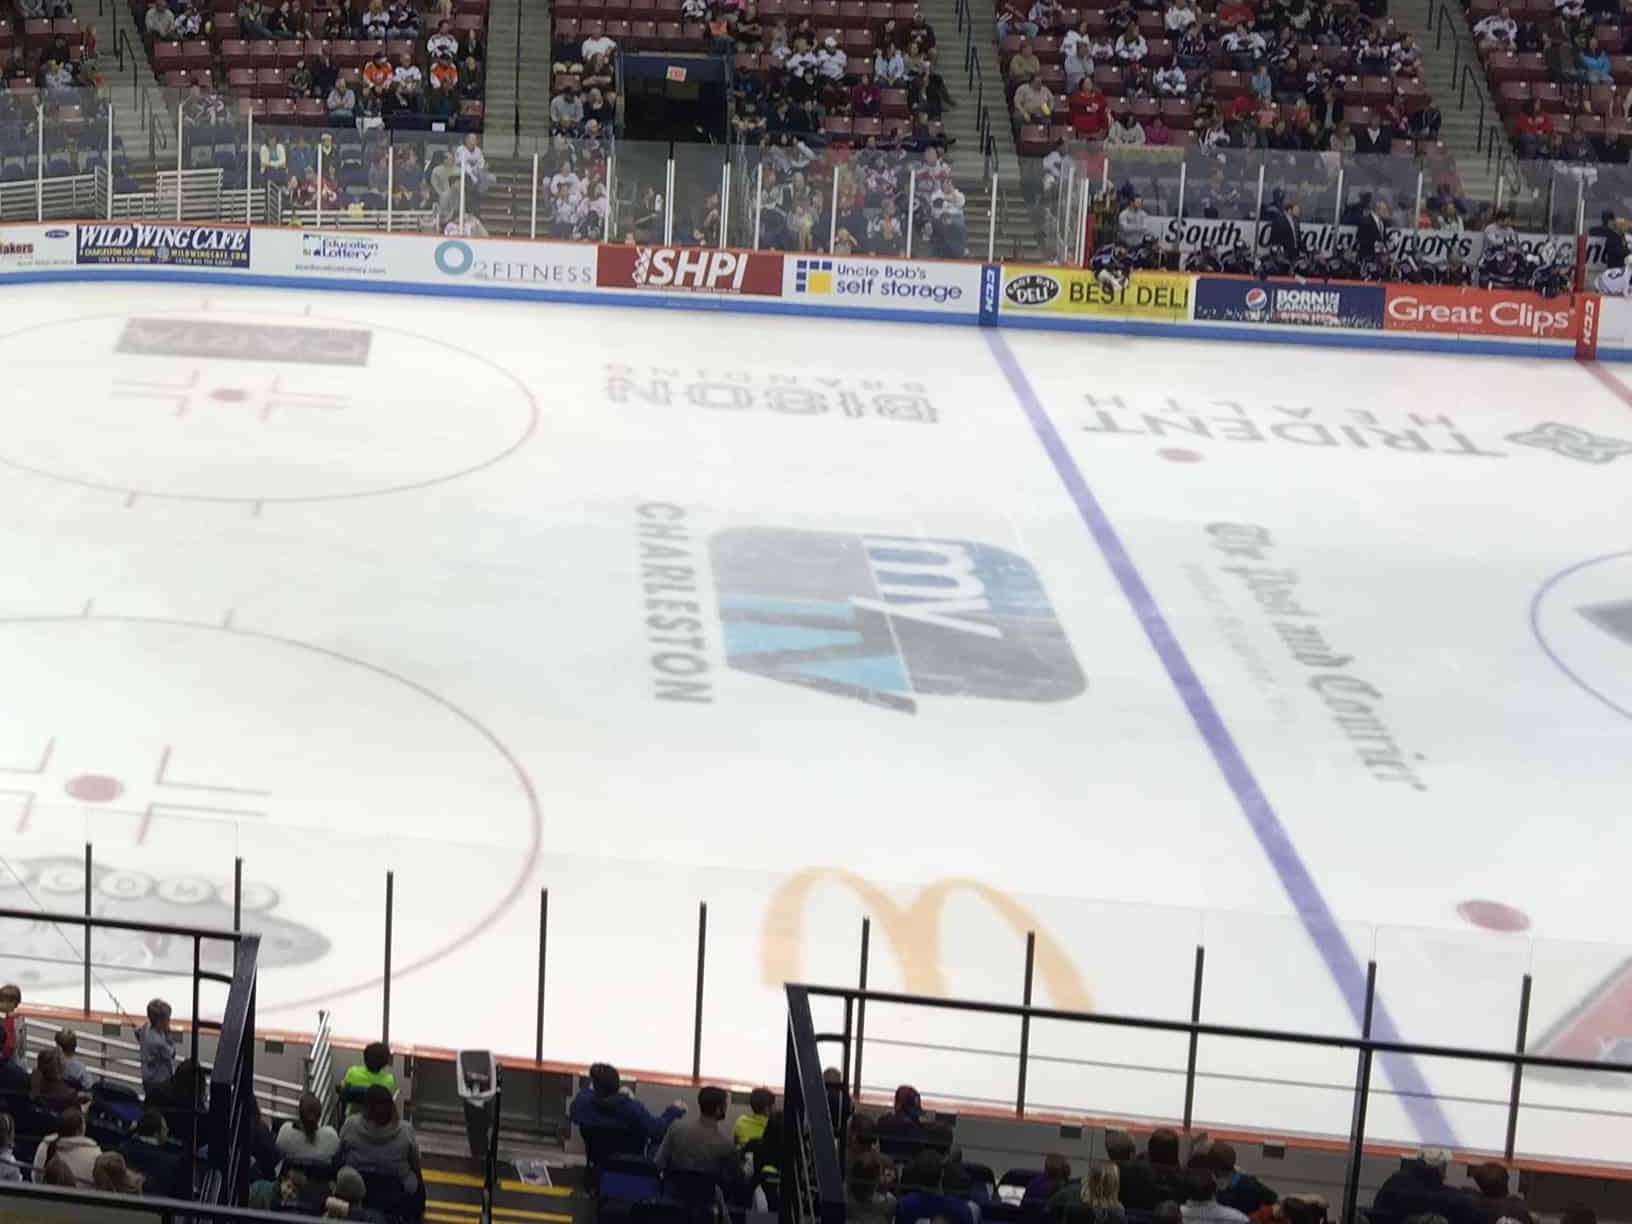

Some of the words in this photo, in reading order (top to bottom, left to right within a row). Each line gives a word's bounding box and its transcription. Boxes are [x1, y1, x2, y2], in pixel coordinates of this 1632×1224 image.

[79, 225, 134, 248] WILD
[133, 224, 193, 249] WING
[192, 225, 248, 251] CAFE
[323, 238, 379, 251] Education
[1165, 219, 1241, 250] South
[1385, 229, 1473, 260] Sports
[322, 247, 372, 261] Lottery
[492, 263, 592, 283] FITNESS
[837, 262, 882, 277] Uncle
[885, 265, 927, 281] Bob's
[837, 277, 878, 295] self
[880, 280, 963, 304] storage
[1016, 286, 1051, 305] DELI
[1069, 280, 1129, 306] BEST
[1136, 284, 1189, 309] DELI
[1277, 288, 1324, 305] BORN
[1388, 296, 1483, 326] Great
[1489, 300, 1570, 337] Clips
[605, 376, 940, 425] BISON
[1083, 393, 1455, 430] HEALTH
[1081, 410, 1510, 458] TRIDENT
[633, 501, 714, 705] CHARLESTON
[1306, 673, 1429, 793] Courier
